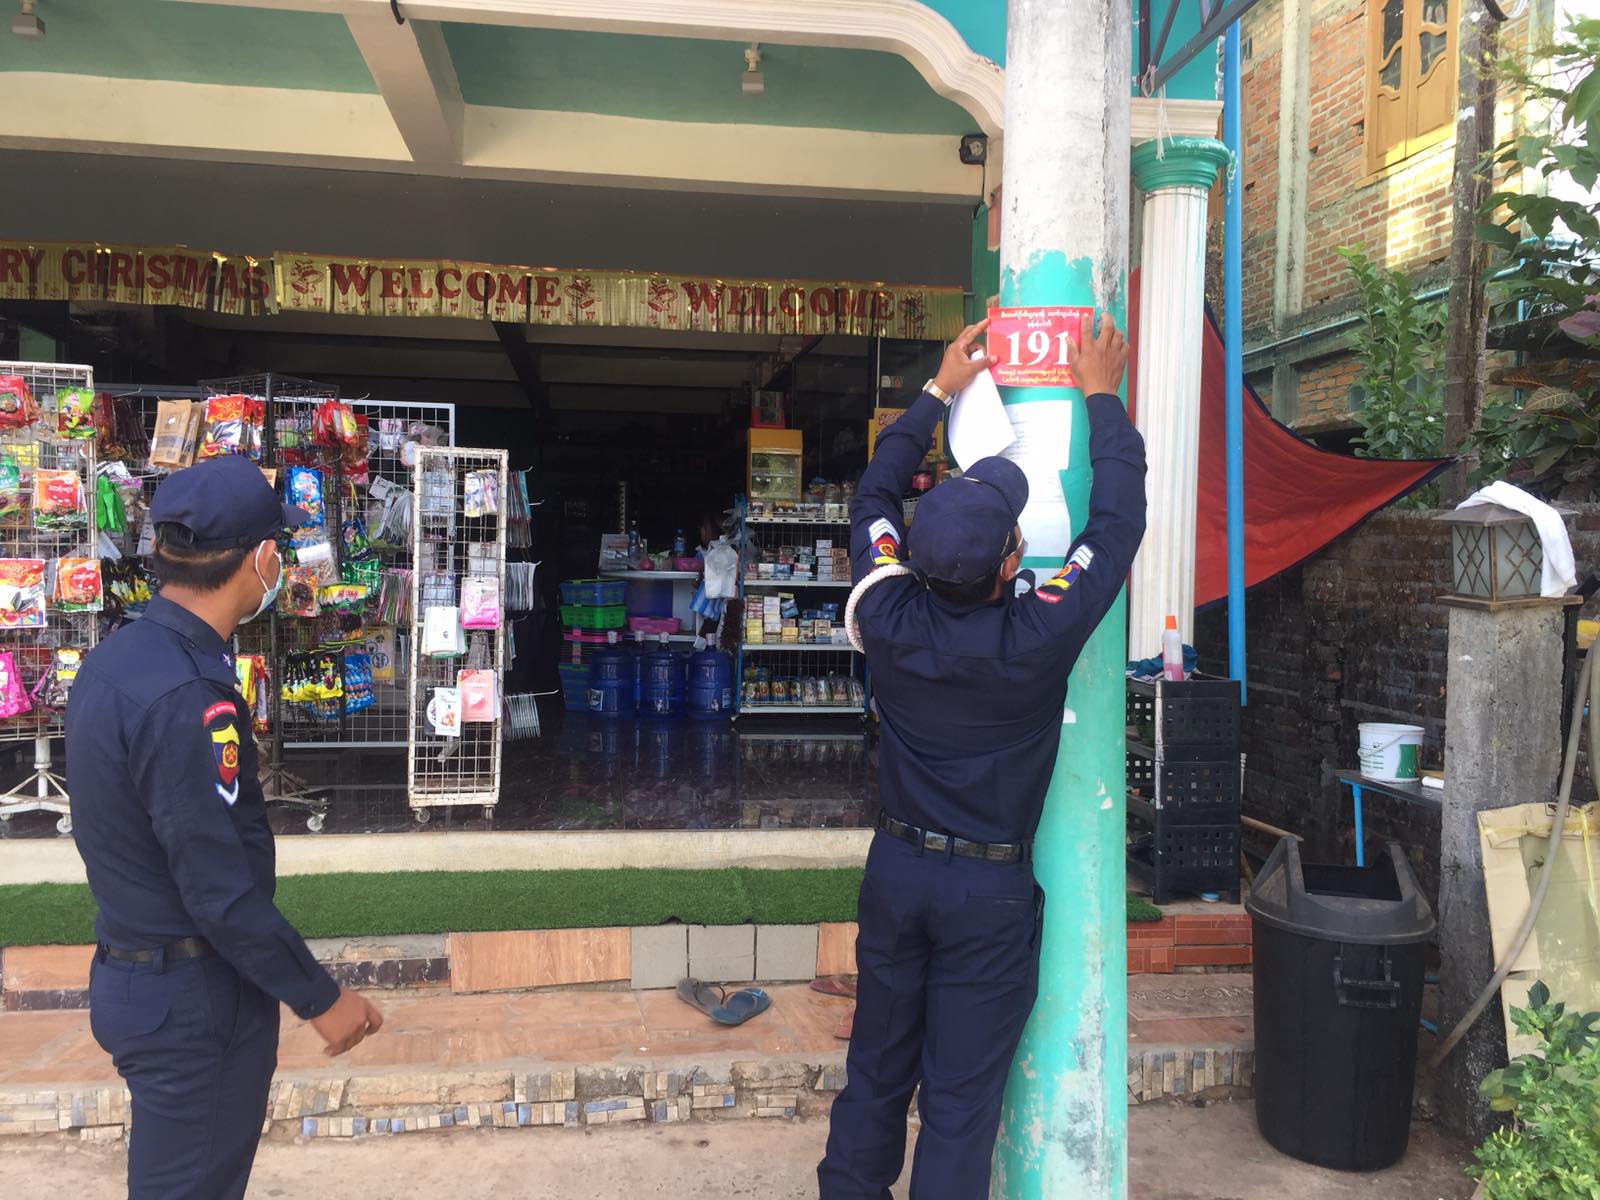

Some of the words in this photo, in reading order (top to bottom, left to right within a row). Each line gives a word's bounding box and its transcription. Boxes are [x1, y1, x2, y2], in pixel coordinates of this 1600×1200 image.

[62, 249, 269, 301] CHRISTMAS
[330, 263, 562, 306] WELCOME
[682, 281, 895, 322] WELCOME
[1005, 330, 1070, 366] 191
